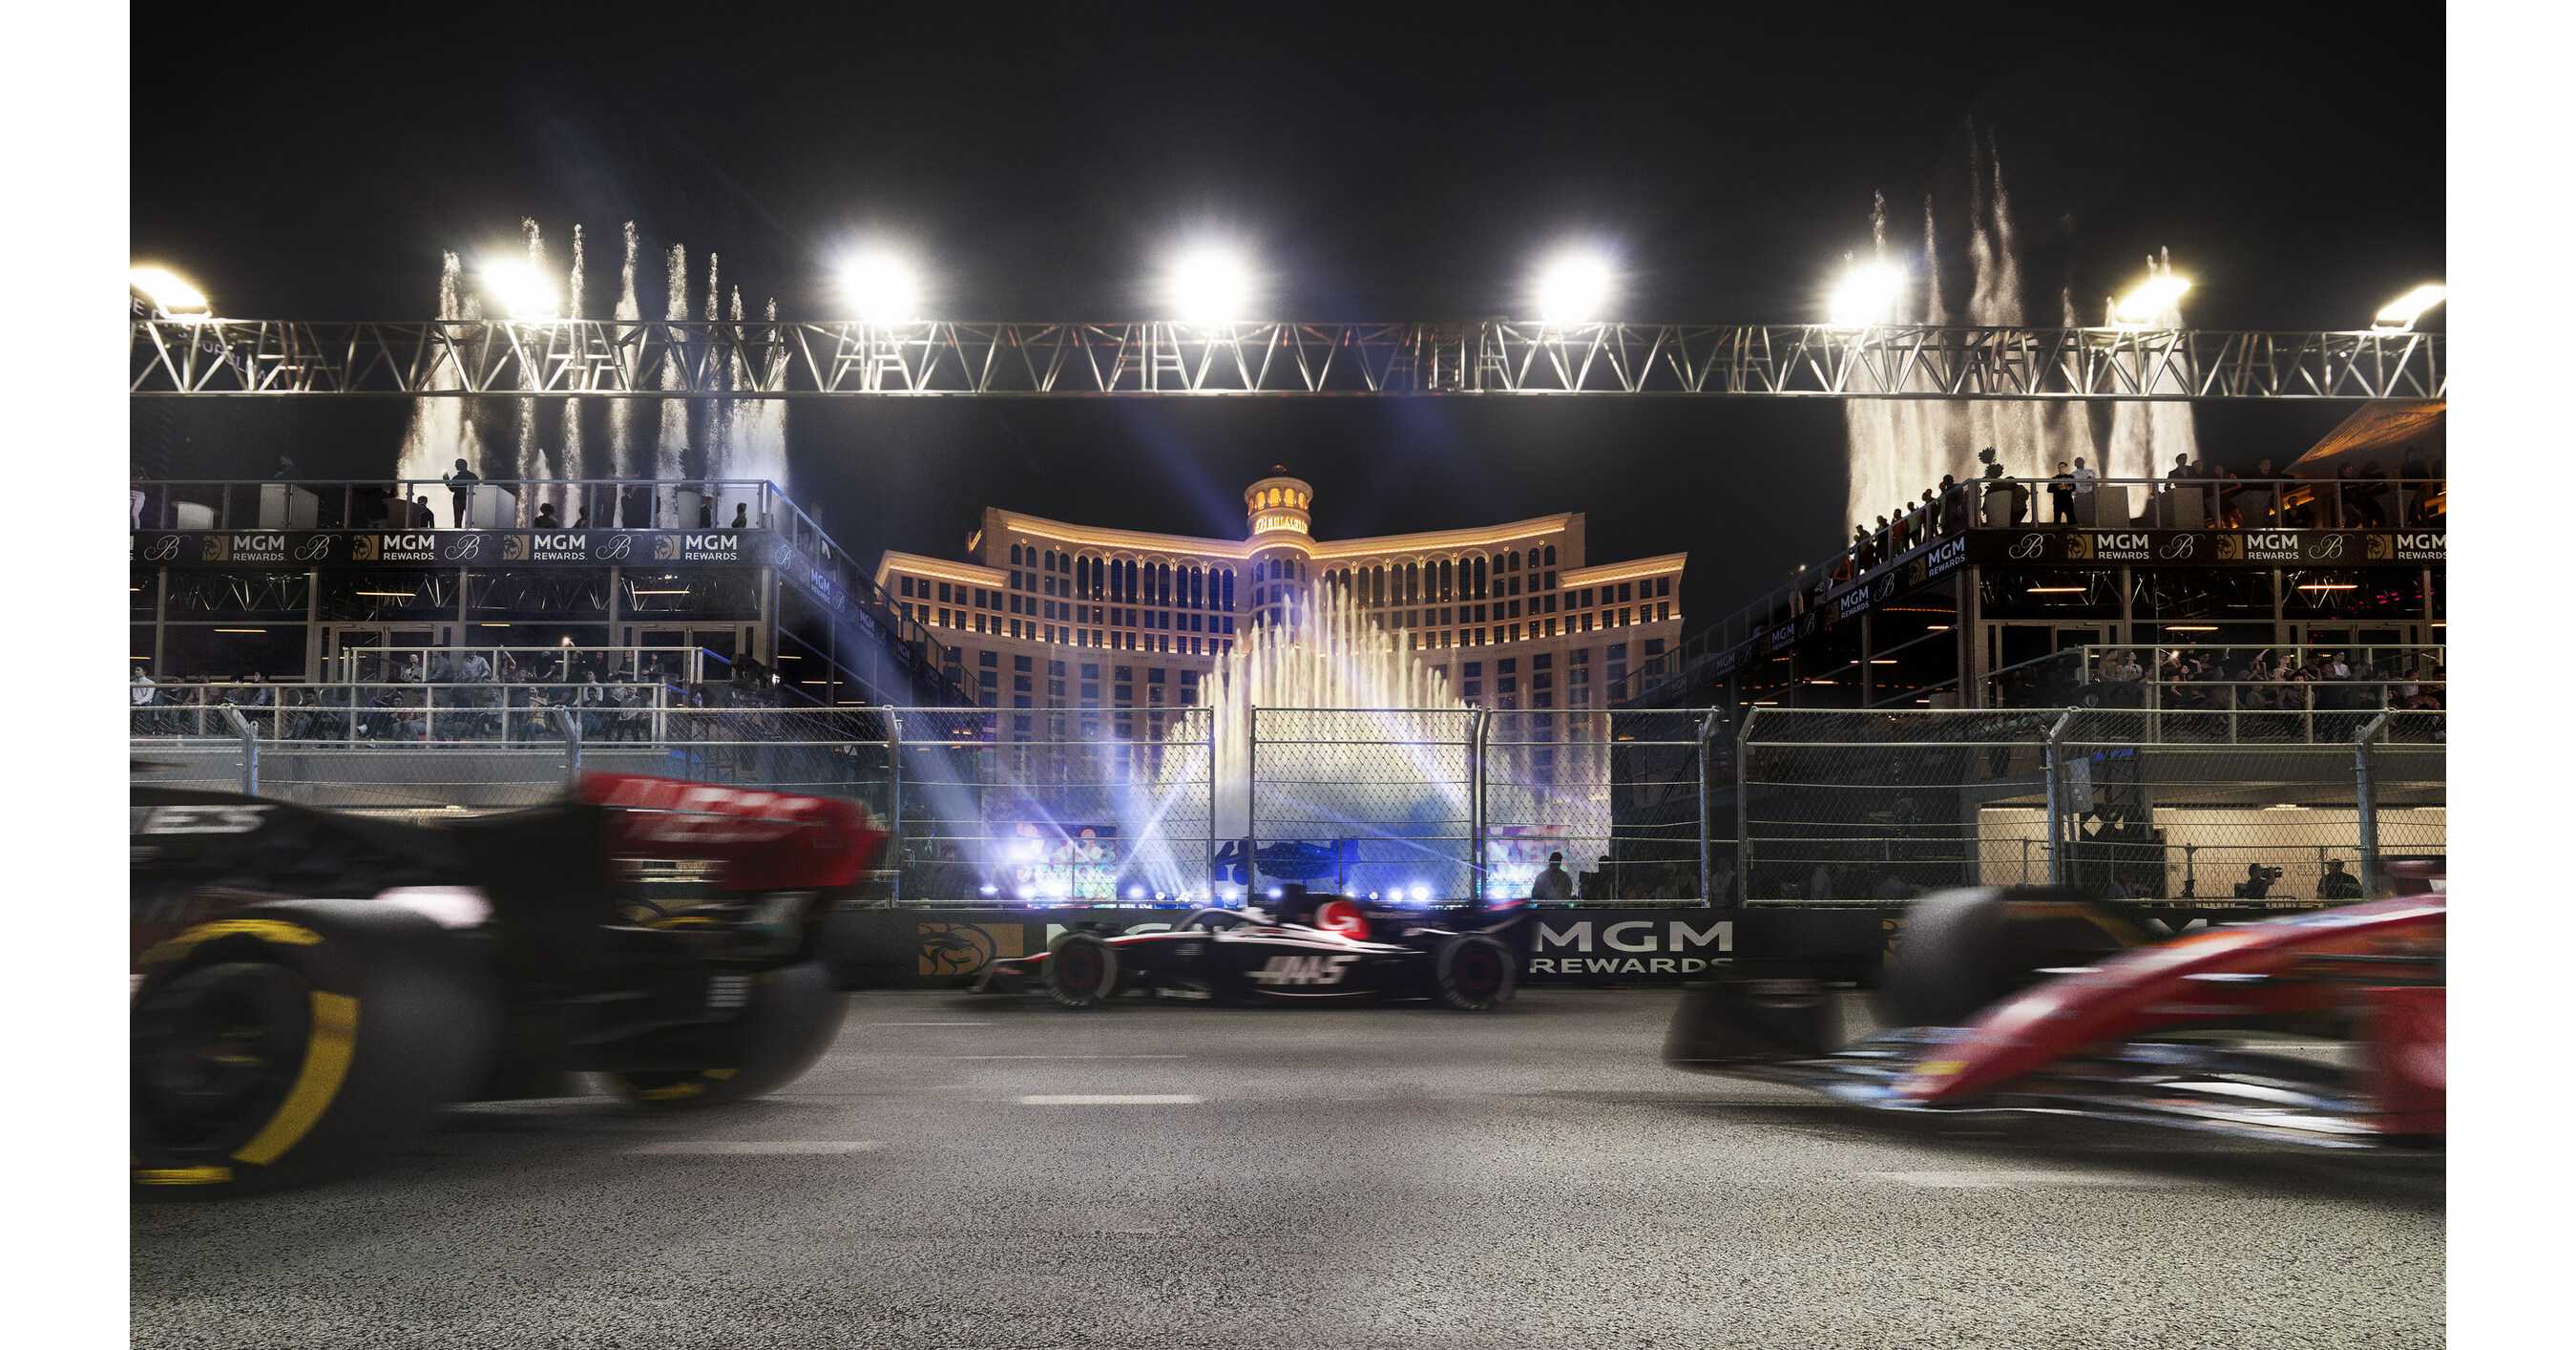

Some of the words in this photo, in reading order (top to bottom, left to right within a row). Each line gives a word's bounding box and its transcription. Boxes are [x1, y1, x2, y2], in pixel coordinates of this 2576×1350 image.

[233, 535, 285, 551] MGM
[383, 535, 435, 550] MGM
[534, 535, 586, 550] MGM
[684, 535, 738, 551] MGM
[2098, 534, 2149, 550] MGM
[2248, 534, 2298, 550] MGM
[2397, 534, 2446, 550] MGM
[233, 553, 284, 561] REWARDS
[384, 553, 435, 561] REWARDS
[534, 552, 586, 561] REWARDS
[685, 552, 738, 561] REWARDS
[1928, 537, 1965, 568] MGM
[2098, 551, 2150, 560] REWARDS
[2248, 551, 2299, 560] REWARDS
[1928, 556, 1966, 578] REWARDS
[809, 567, 830, 597] MGM
[810, 583, 831, 605] REWARDS
[1840, 585, 1869, 610] MGM
[1840, 601, 1870, 620] REWARDS
[859, 607, 875, 632] MGM
[1771, 622, 1795, 644] MGM
[1529, 920, 1734, 953] MGM
